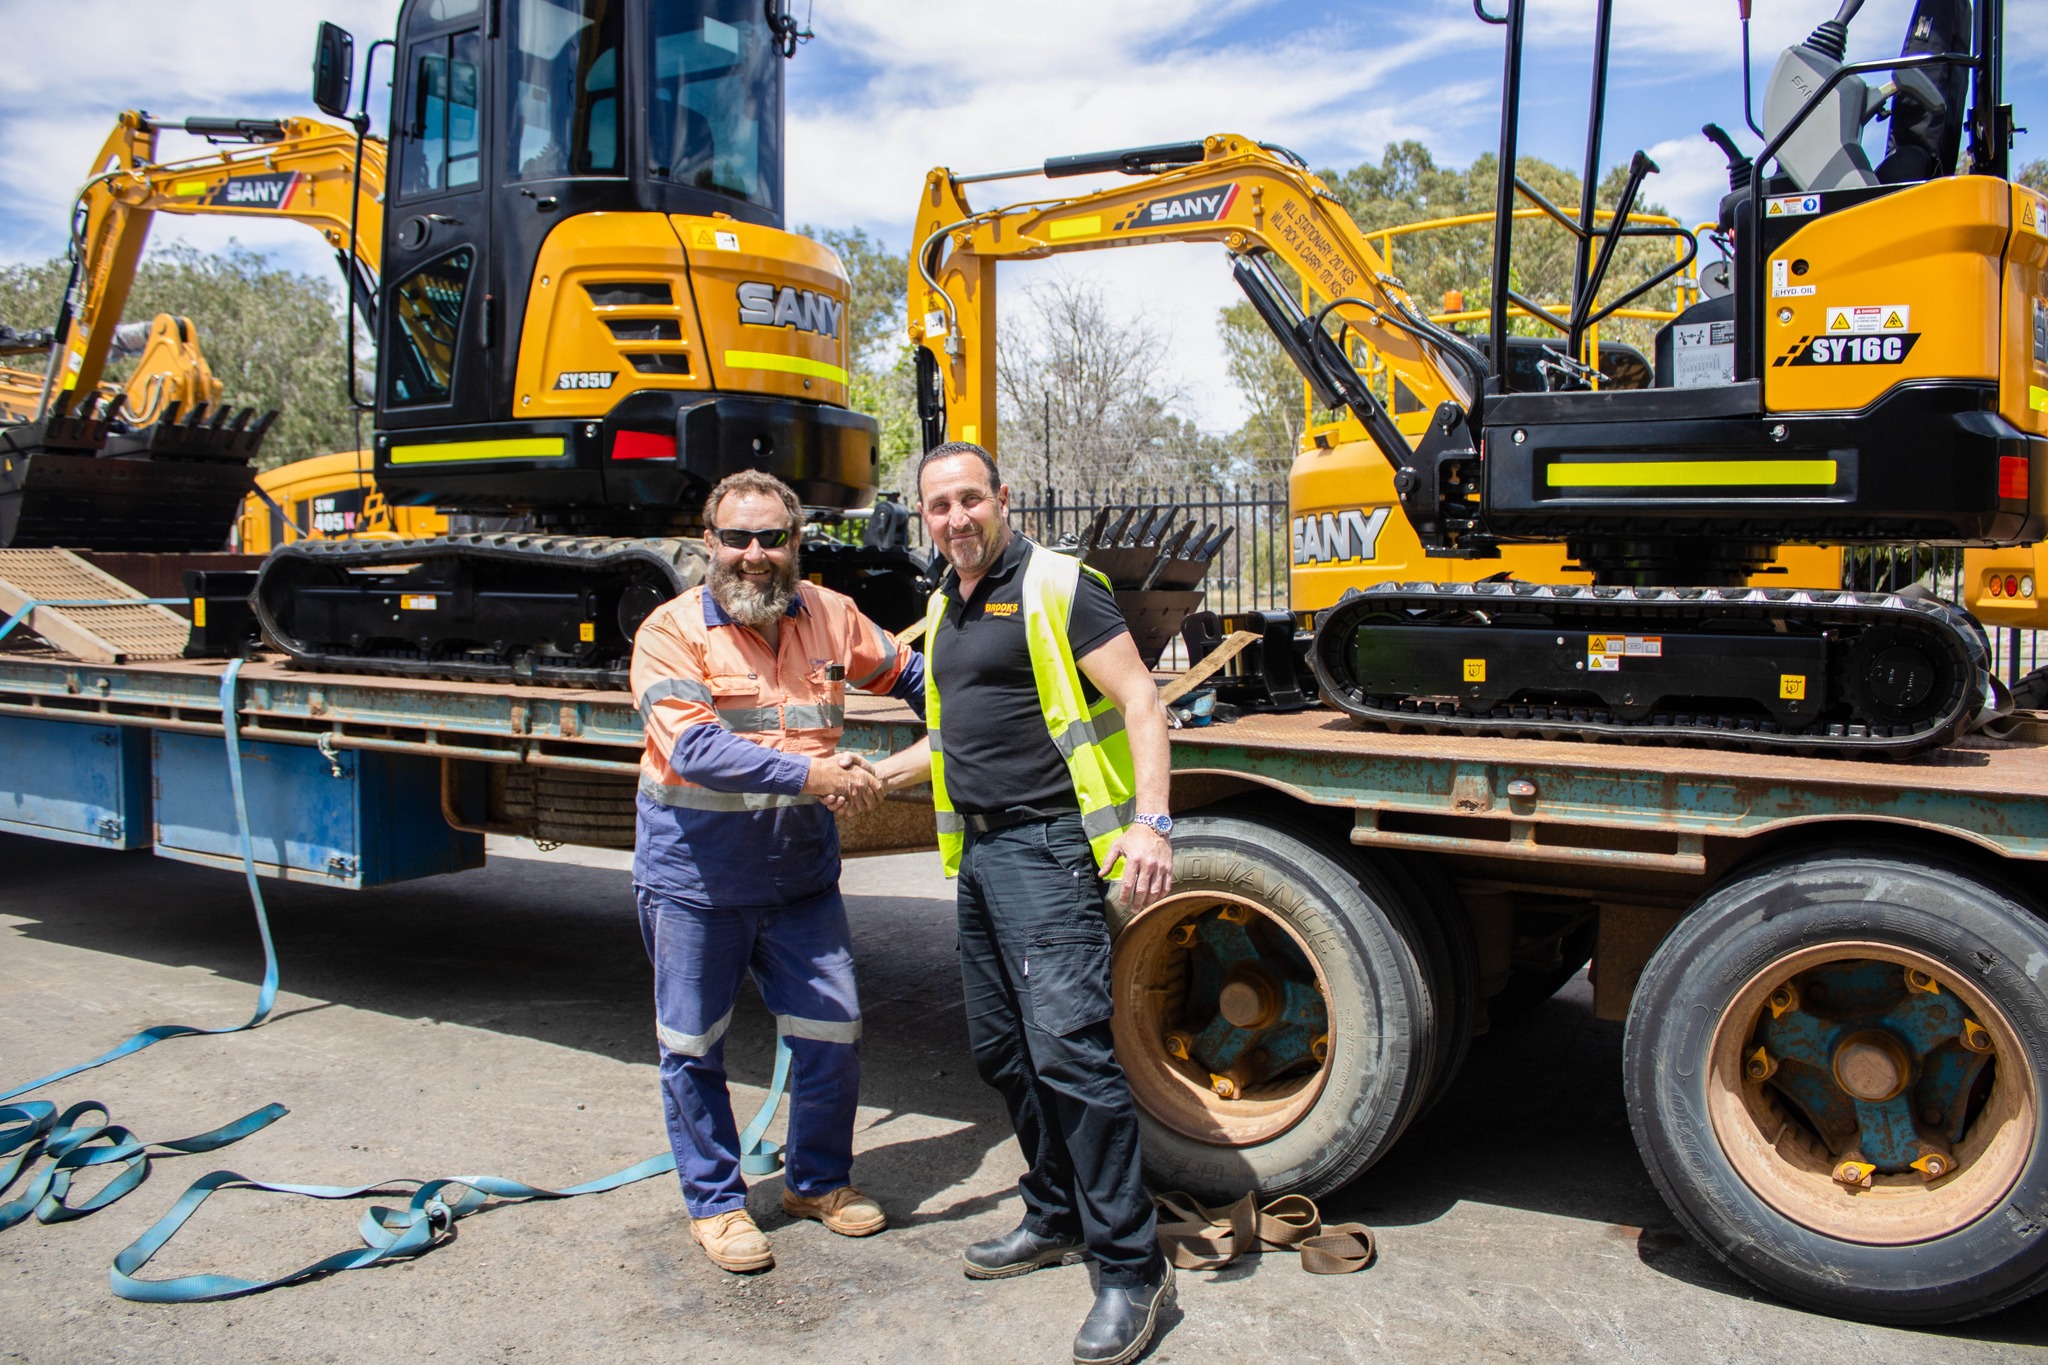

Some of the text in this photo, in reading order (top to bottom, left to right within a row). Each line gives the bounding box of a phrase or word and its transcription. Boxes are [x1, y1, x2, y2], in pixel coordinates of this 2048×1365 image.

[226, 181, 284, 202] SANY
[1150, 195, 1220, 221] SANY
[1270, 210, 1286, 231] WLL
[1281, 224, 1300, 246] PICK
[1294, 240, 1305, 251] &
[1319, 268, 1334, 285] 170
[1327, 278, 1346, 298] KGS
[1282, 198, 1298, 219] WLL
[1329, 254, 1345, 271] 210
[1339, 266, 1358, 286] KGS
[737, 280, 842, 339] SANY
[1812, 336, 1902, 363] SY16C
[560, 372, 612, 389] SY35U
[315, 498, 336, 513] SW
[313, 511, 356, 532] 405K
[1293, 506, 1391, 565] SANY
[984, 602, 1018, 613] BROOKS
[1172, 855, 1345, 954] DVANCE
[1669, 1093, 1809, 1262] SUMITOMO
